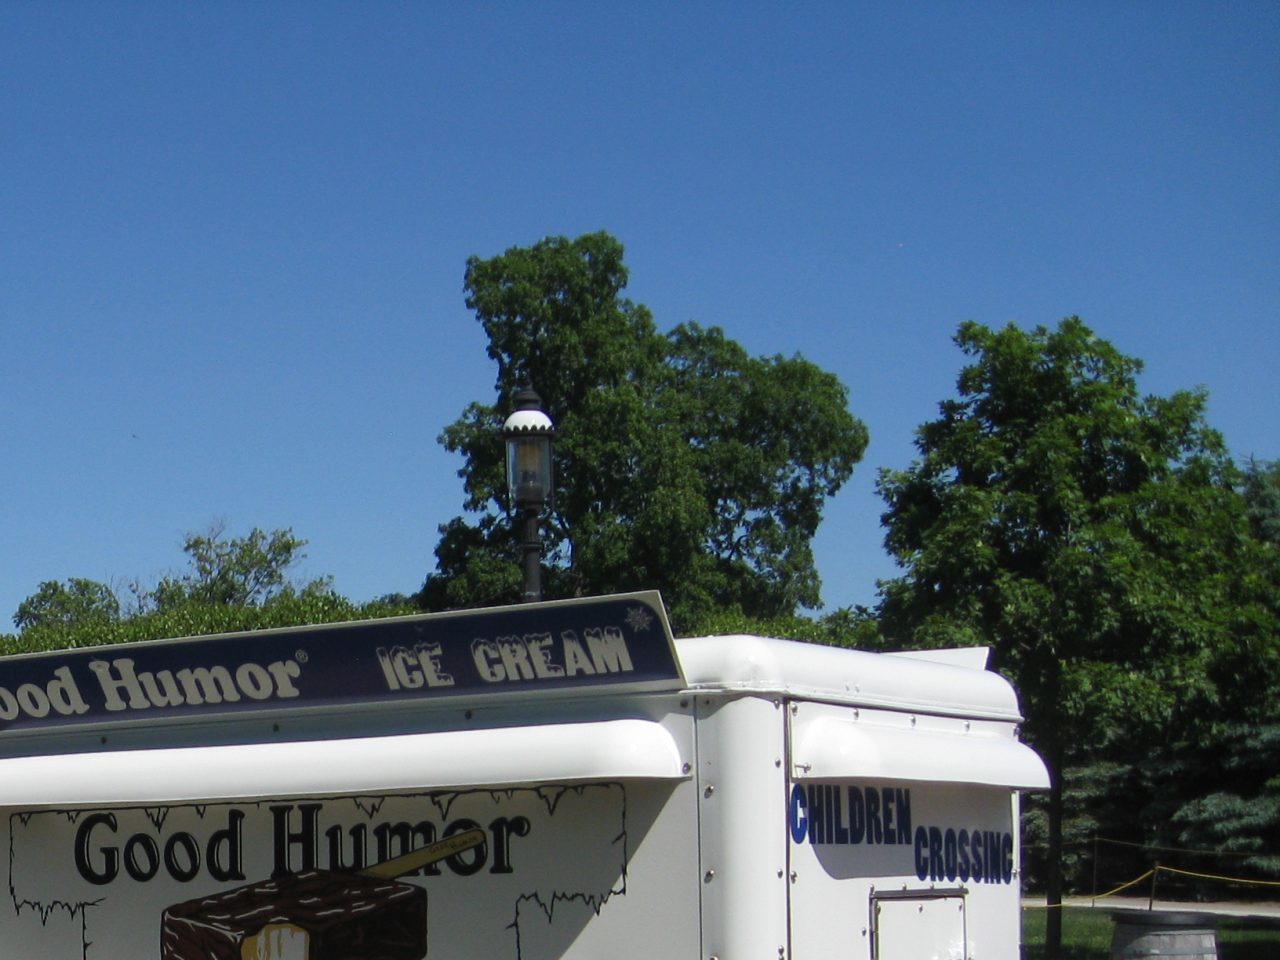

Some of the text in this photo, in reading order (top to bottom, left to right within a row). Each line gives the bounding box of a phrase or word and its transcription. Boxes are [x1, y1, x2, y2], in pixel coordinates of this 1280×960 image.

[376, 641, 456, 691] ICE
[471, 625, 634, 684] CREAM
[74, 803, 531, 886] Good Humor
[790, 783, 912, 846] CHILDREN
[914, 826, 1013, 885] CROSSING
